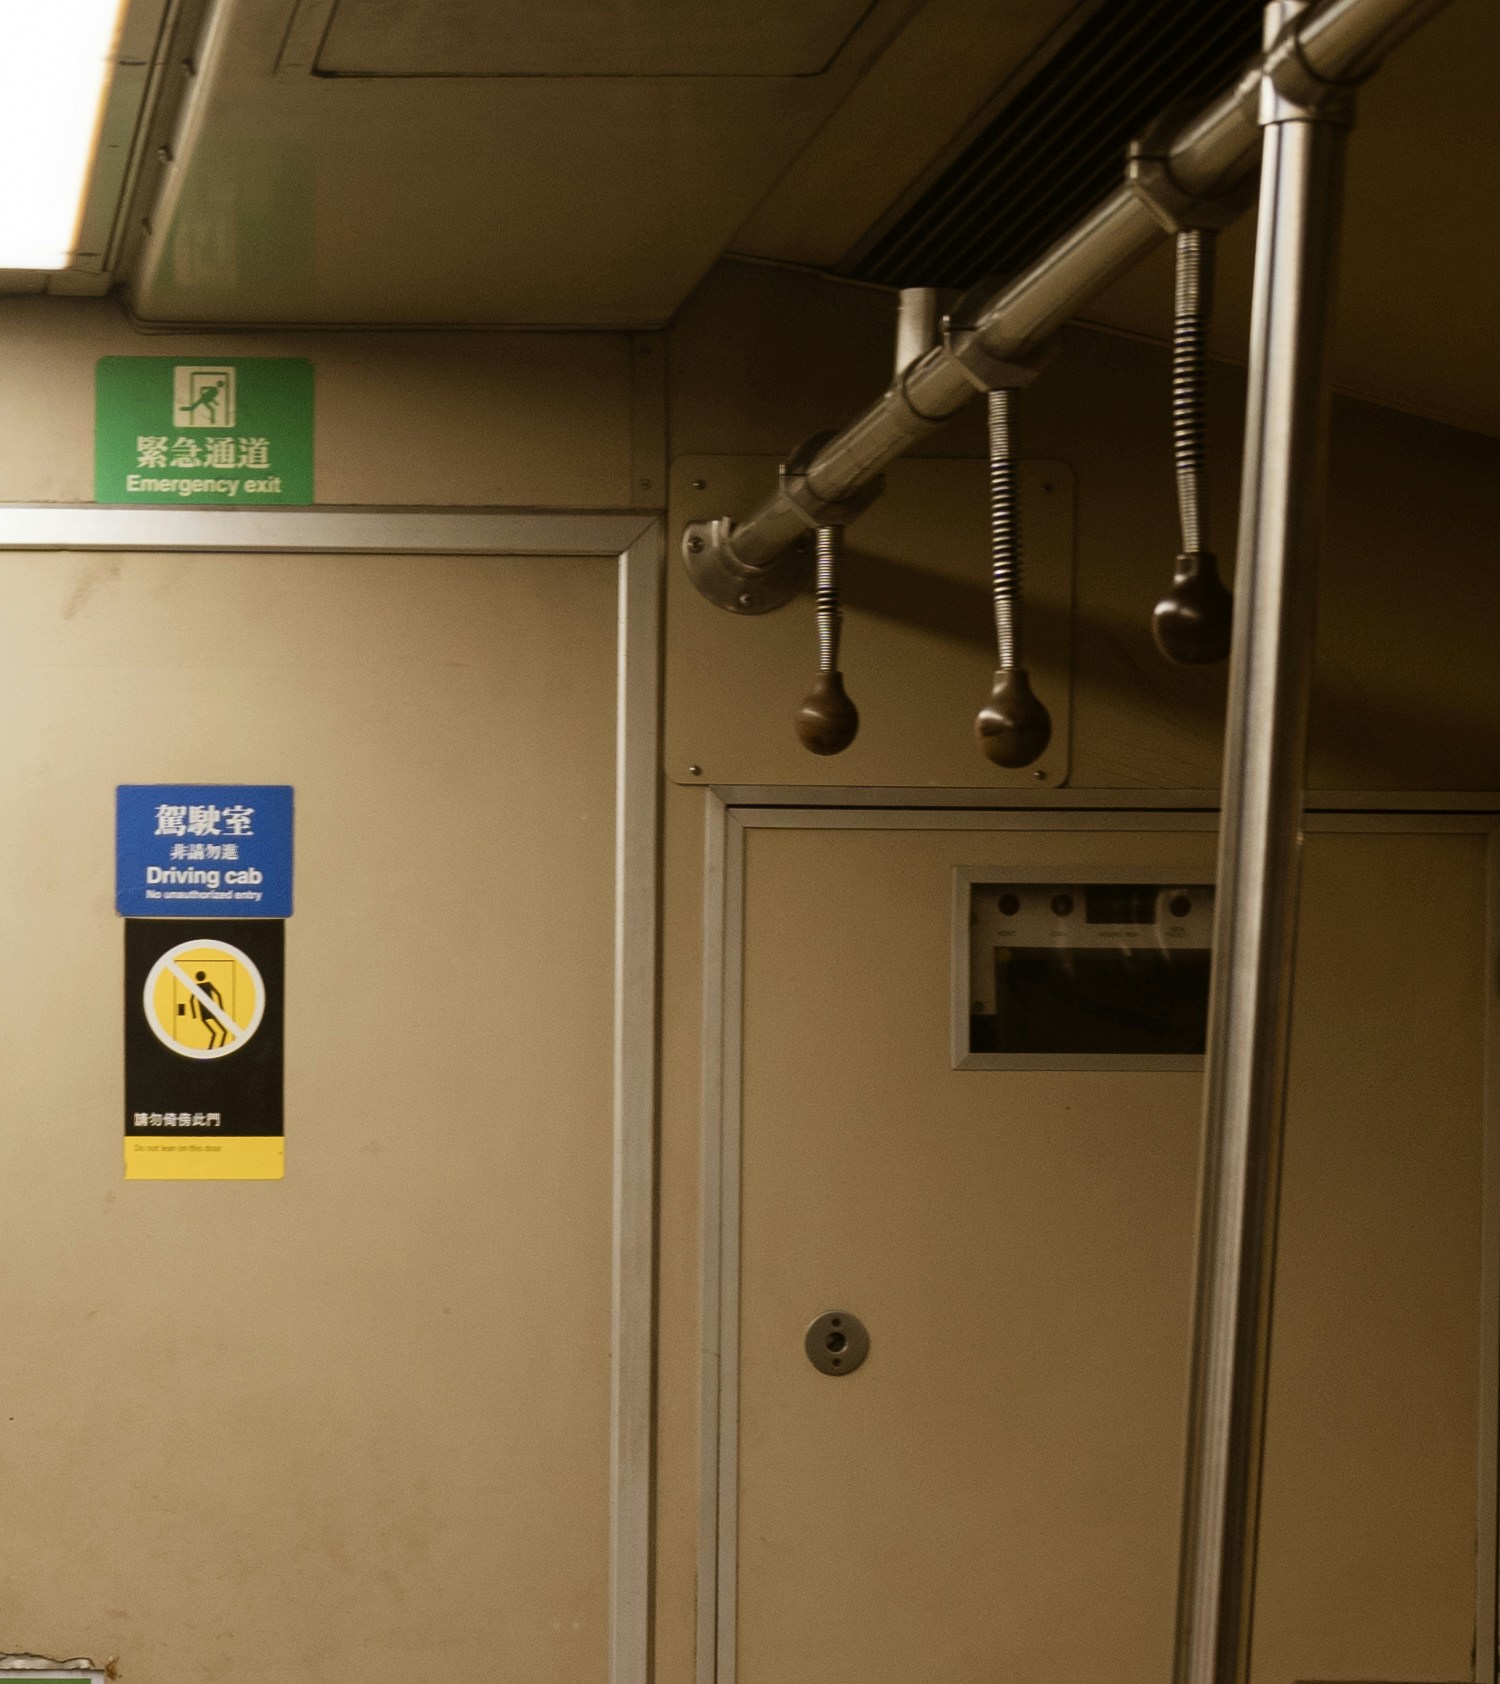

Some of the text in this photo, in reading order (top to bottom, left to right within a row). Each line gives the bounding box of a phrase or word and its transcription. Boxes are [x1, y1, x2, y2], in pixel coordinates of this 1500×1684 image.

[136, 436, 271, 469] 緊急通道
[126, 474, 282, 497] Emergency exit
[154, 804, 255, 836] 駕駛室
[170, 843, 239, 860] 非請勿進
[146, 866, 263, 888] Driving cab
[145, 890, 162, 899] No
[234, 890, 263, 901] entry
